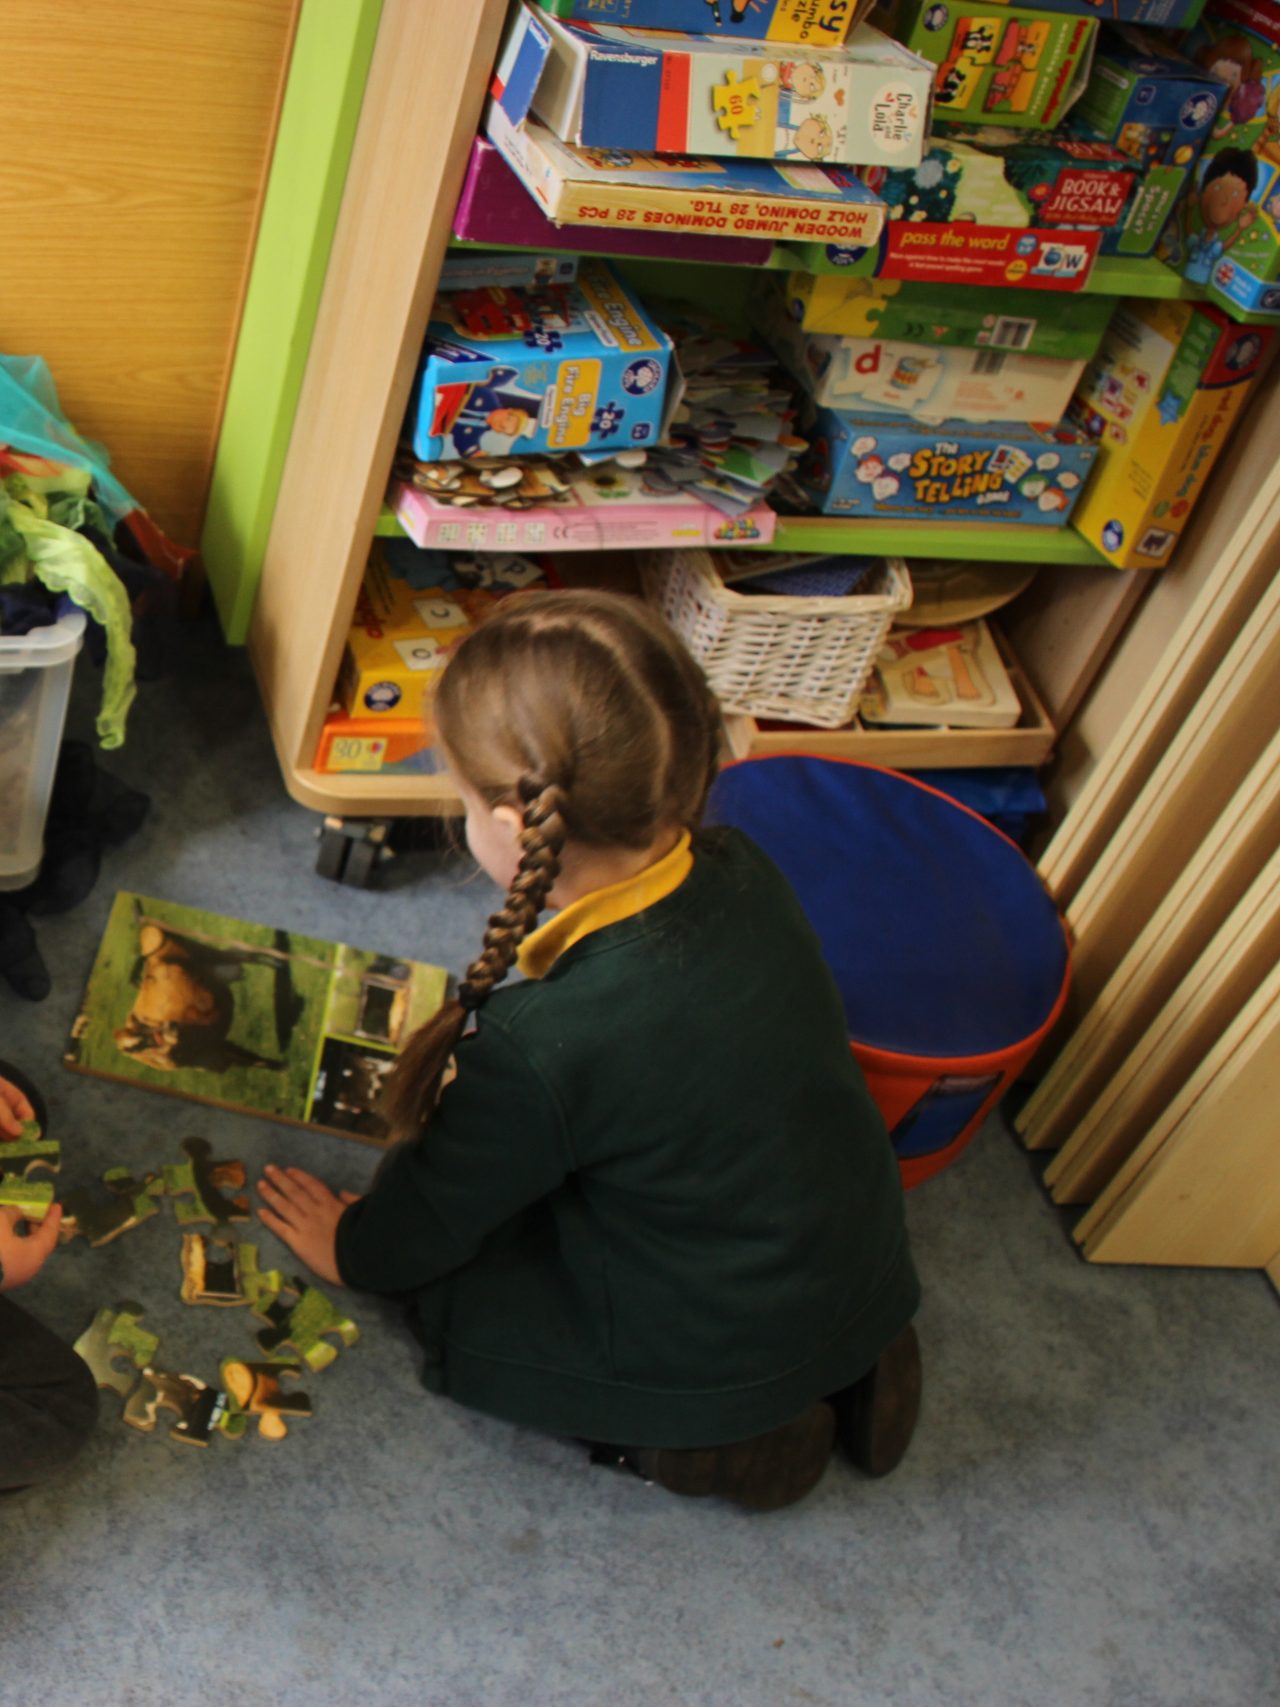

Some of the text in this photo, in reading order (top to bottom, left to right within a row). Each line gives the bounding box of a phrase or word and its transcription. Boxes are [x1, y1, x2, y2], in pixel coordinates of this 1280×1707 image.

[800, 0, 823, 40] umbo
[589, 50, 659, 67] Ravensburger
[728, 94, 744, 115] 60
[872, 103, 891, 133] Lola
[894, 92, 913, 142] Charlie
[1061, 178, 1108, 196] BOOK
[689, 199, 869, 225] HOLZ DOMINO, 28 TLG.
[1048, 195, 1123, 214] JIGSAW
[577, 205, 863, 238] WOODEN JUMBO DOMINOES 28 PCS
[900, 231, 937, 248] pass
[940, 229, 965, 247] the
[969, 232, 1010, 250] word
[605, 301, 644, 347] Engine
[855, 343, 883, 375] d
[555, 366, 580, 445] Fire Engine
[572, 393, 593, 417] Big
[599, 411, 616, 430] 20
[908, 447, 993, 478] STORY
